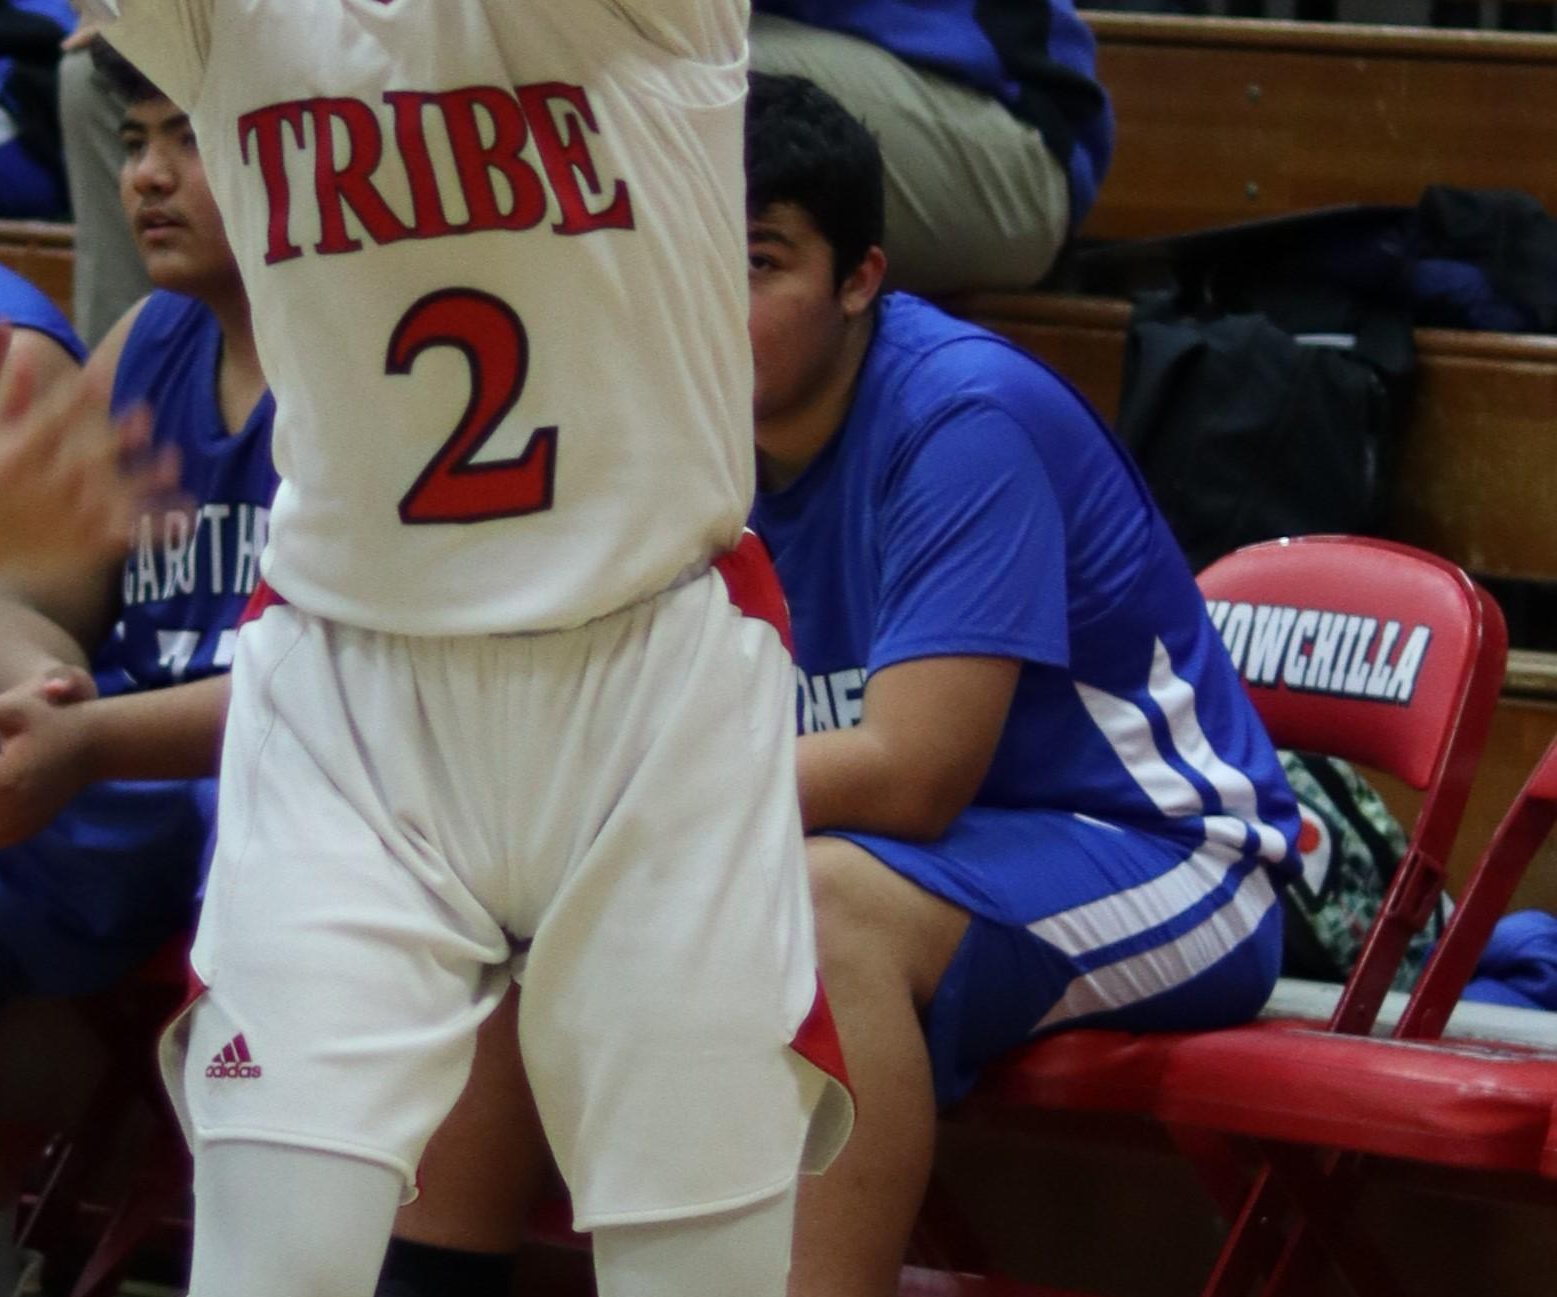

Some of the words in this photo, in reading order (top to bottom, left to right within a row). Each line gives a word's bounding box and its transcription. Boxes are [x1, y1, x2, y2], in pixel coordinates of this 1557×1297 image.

[238, 81, 636, 266] TRIBE
[384, 286, 558, 526] 2
[205, 1061, 262, 1079] adidas
